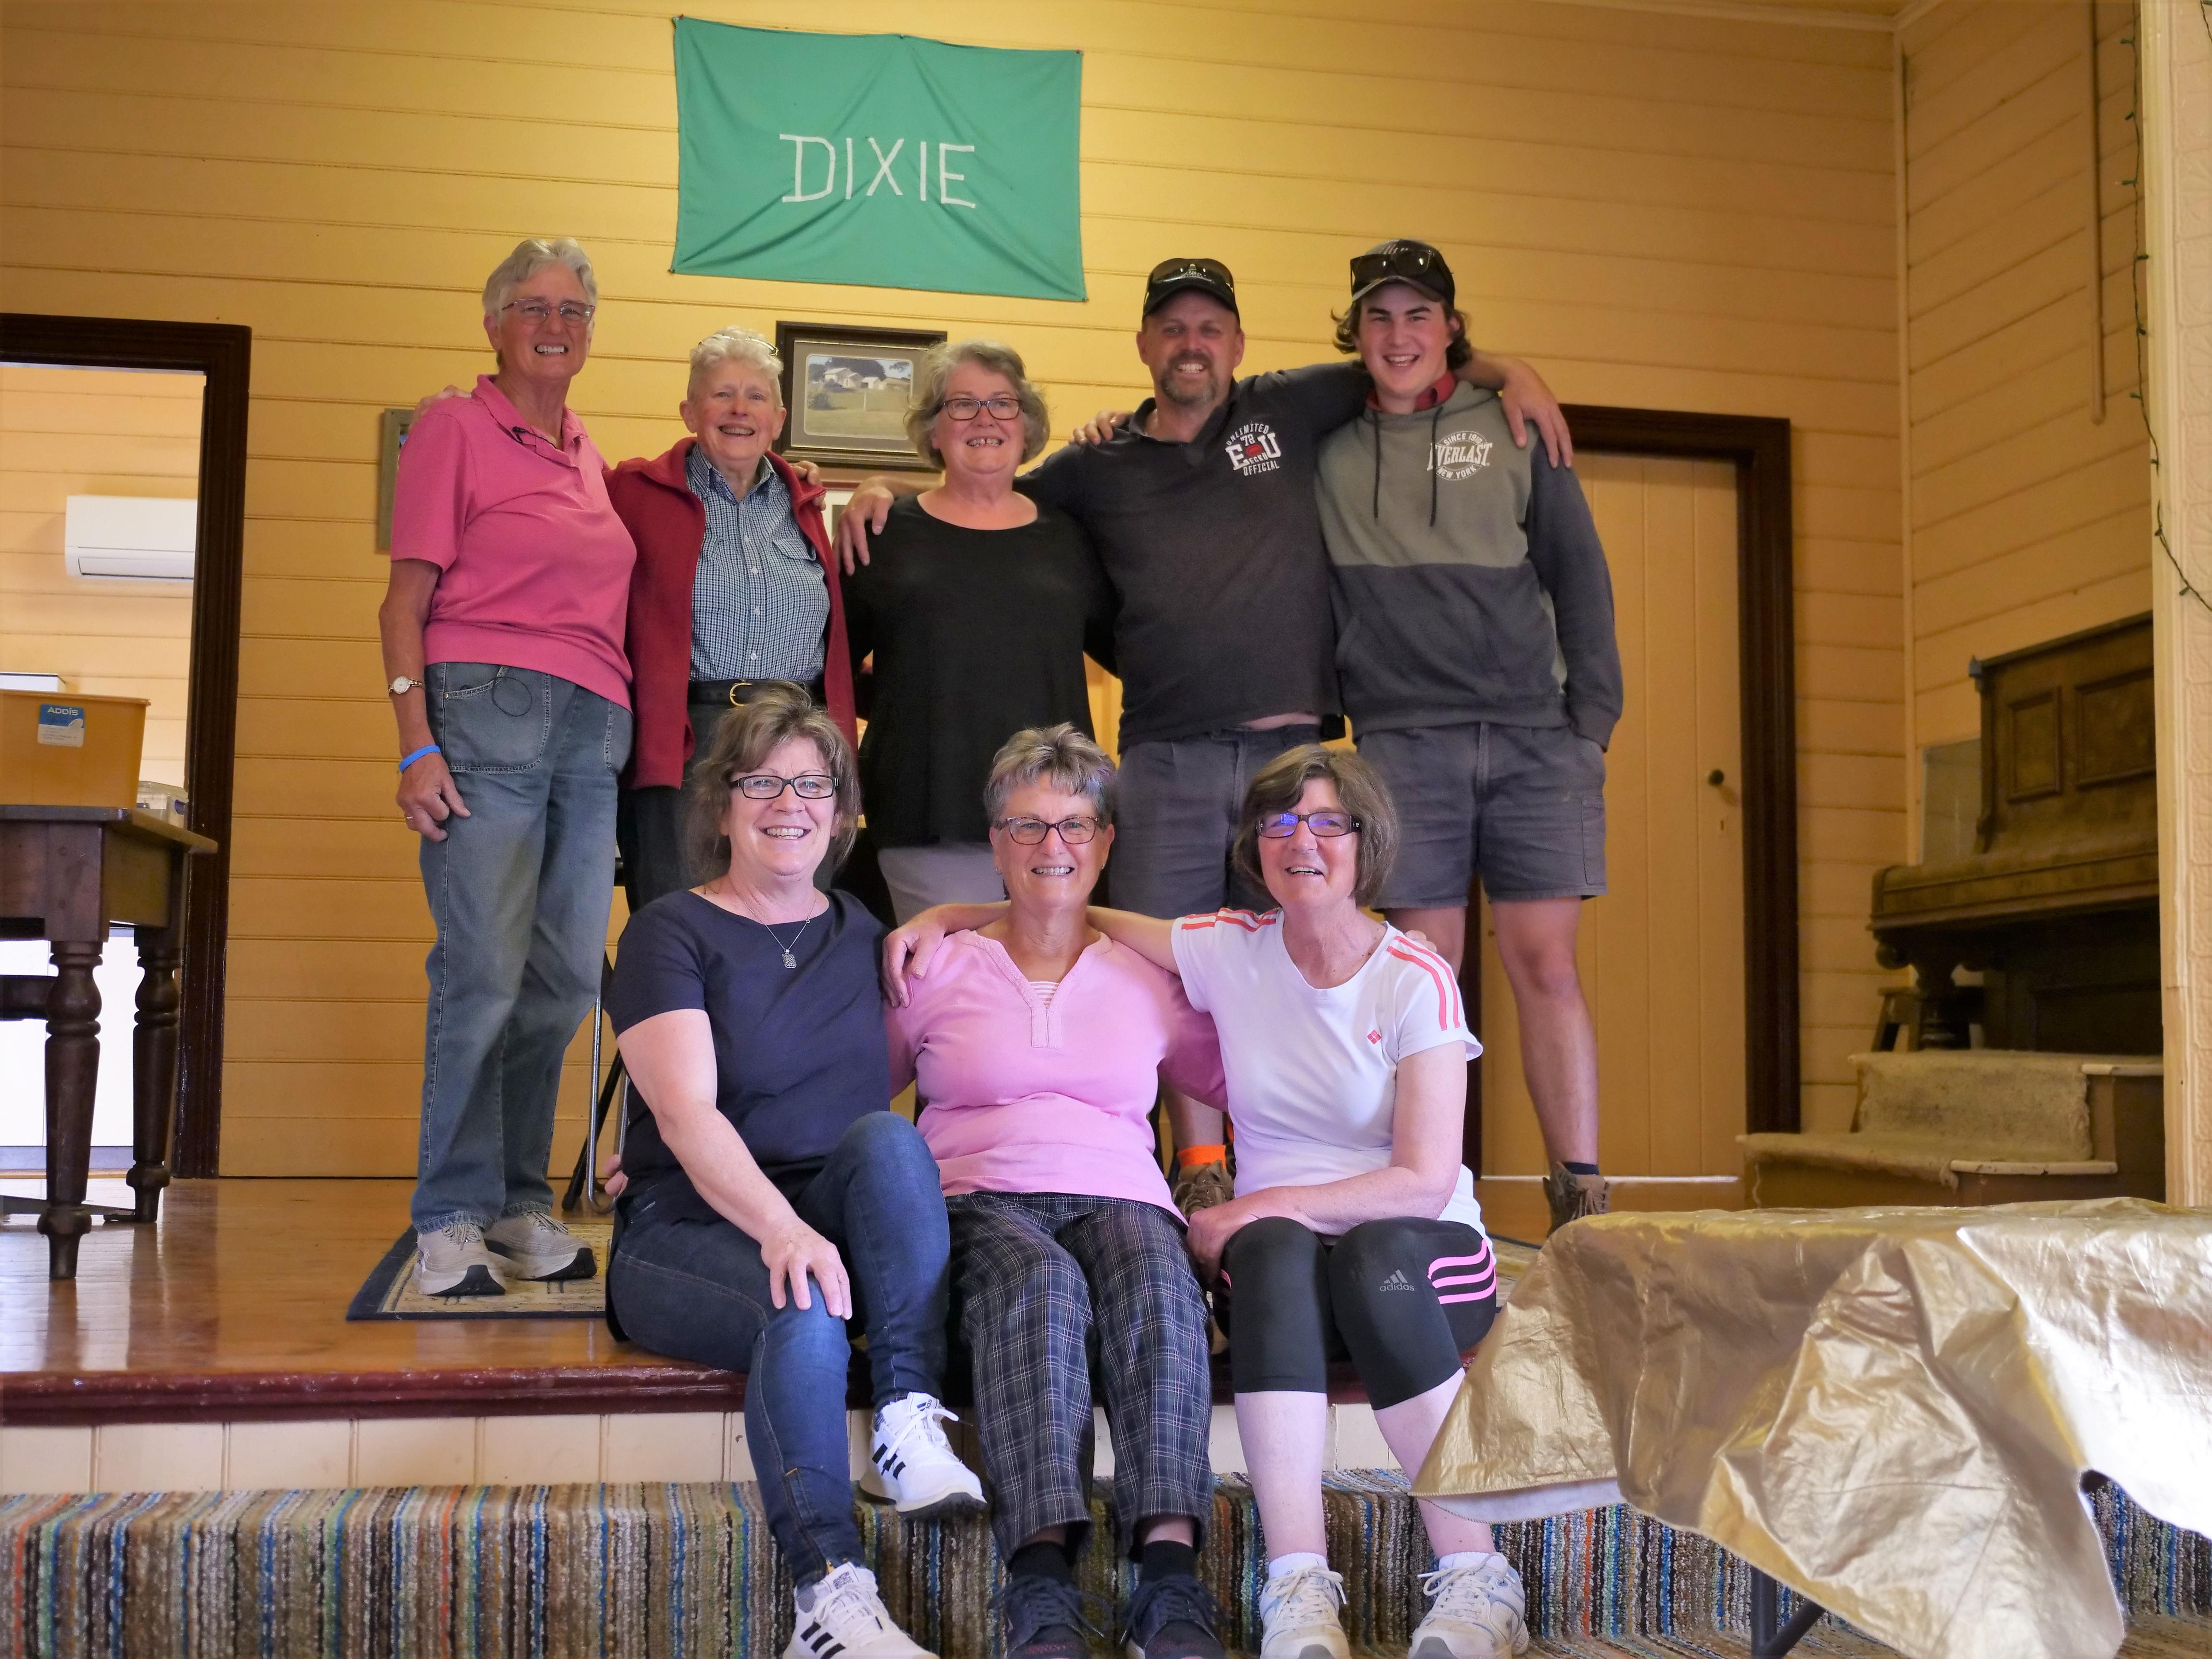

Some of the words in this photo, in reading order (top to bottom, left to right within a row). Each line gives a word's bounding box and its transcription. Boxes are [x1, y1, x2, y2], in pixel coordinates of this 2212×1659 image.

[780, 134, 975, 208] DIXIE
[1226, 423, 1269, 445] UNLIMITED
[1444, 433, 1466, 445] SINCE
[1248, 452, 1268, 464] ECKO
[1243, 461, 1280, 476] OFFICIAL
[1436, 467, 1453, 479] NEW
[1456, 465, 1476, 479] YORK
[1379, 1283, 1415, 1291] adidas
